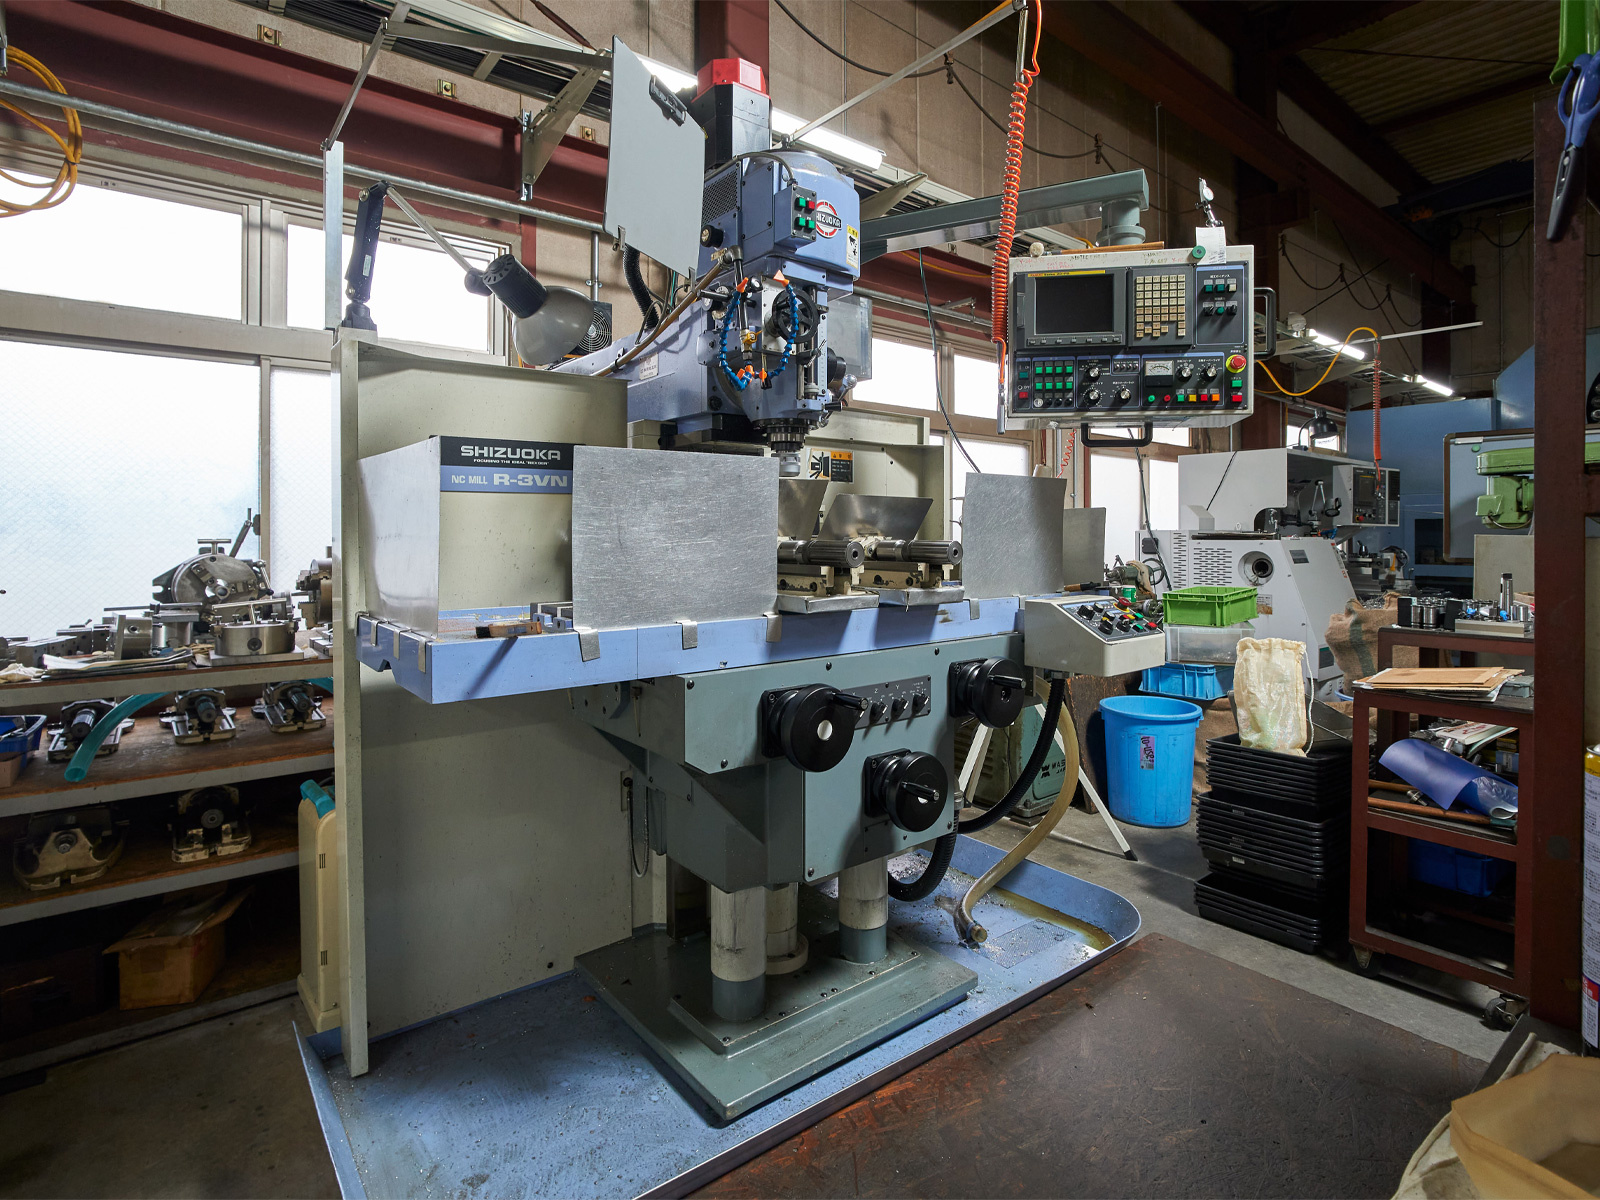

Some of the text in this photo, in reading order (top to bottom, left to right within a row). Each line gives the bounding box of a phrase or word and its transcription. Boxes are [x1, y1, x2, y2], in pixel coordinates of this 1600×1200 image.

[815, 212, 840, 228] HIZUOKA
[460, 445, 561, 460] SHIZUOKA
[451, 473, 568, 487] NC MILL R-3VN
